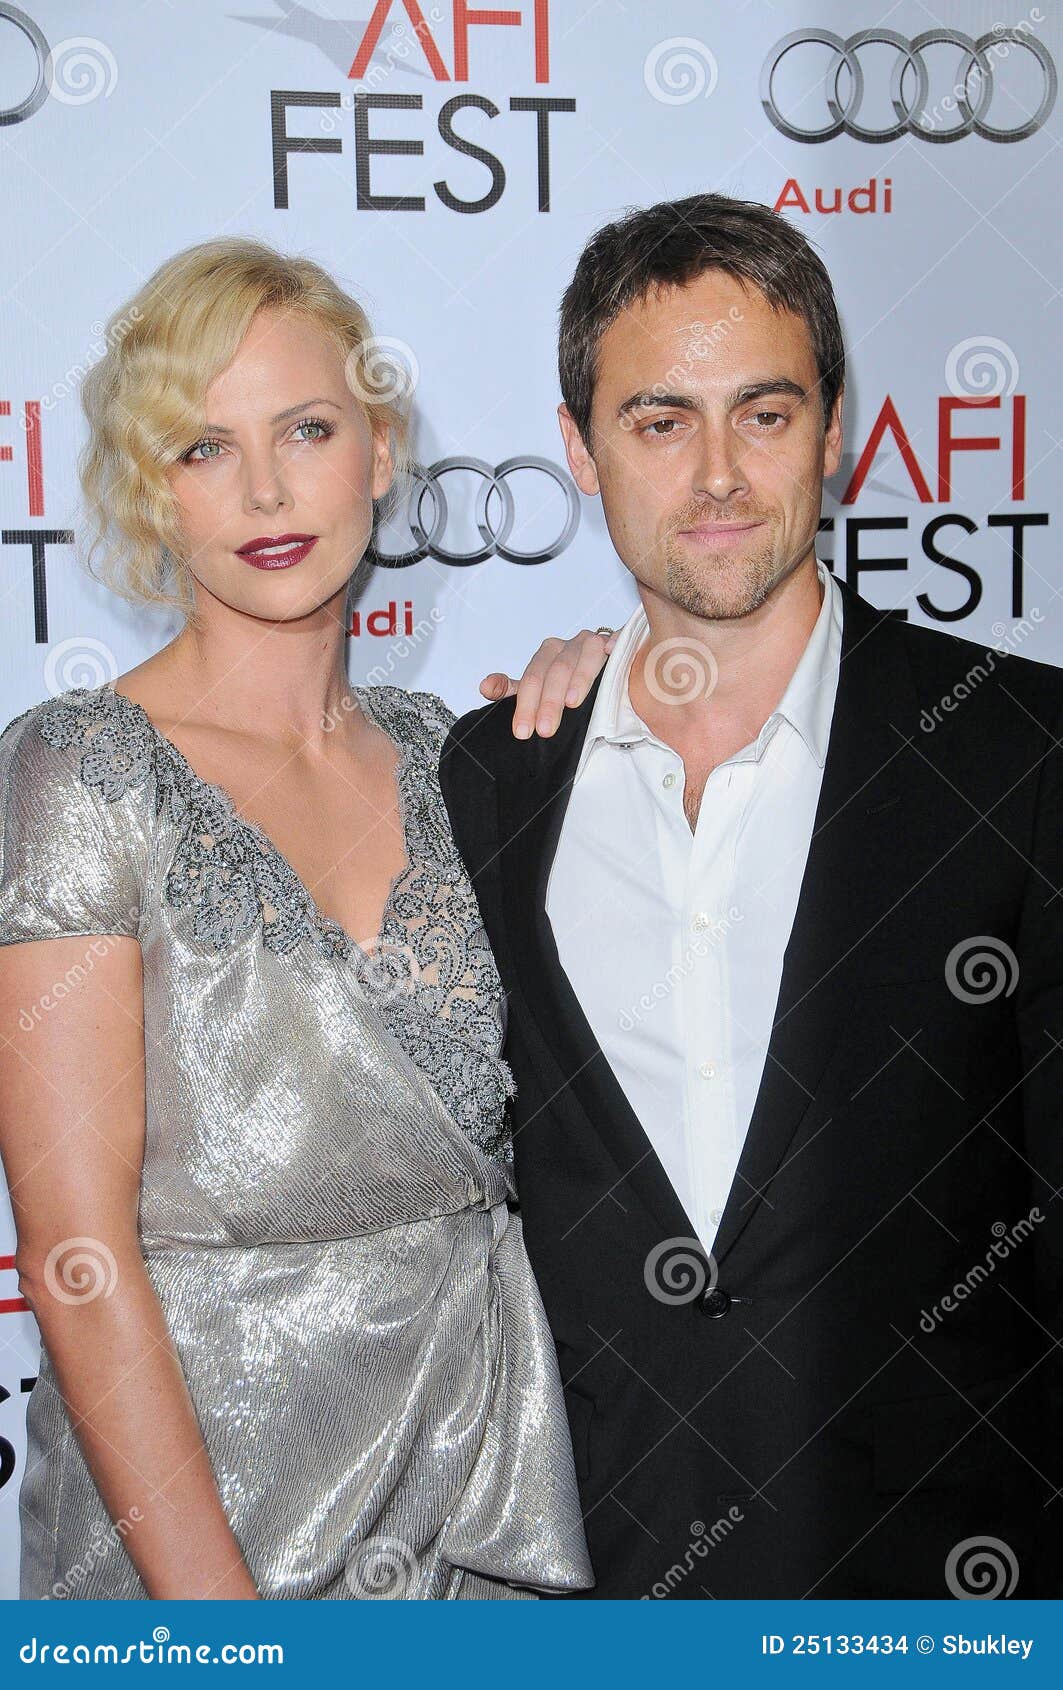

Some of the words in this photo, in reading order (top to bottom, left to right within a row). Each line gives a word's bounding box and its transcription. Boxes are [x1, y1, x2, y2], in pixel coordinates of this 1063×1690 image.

[271, 90, 577, 214] FEST
[773, 178, 892, 214] Audi
[840, 394, 1026, 505] AFI
[817, 513, 1049, 622] EST
